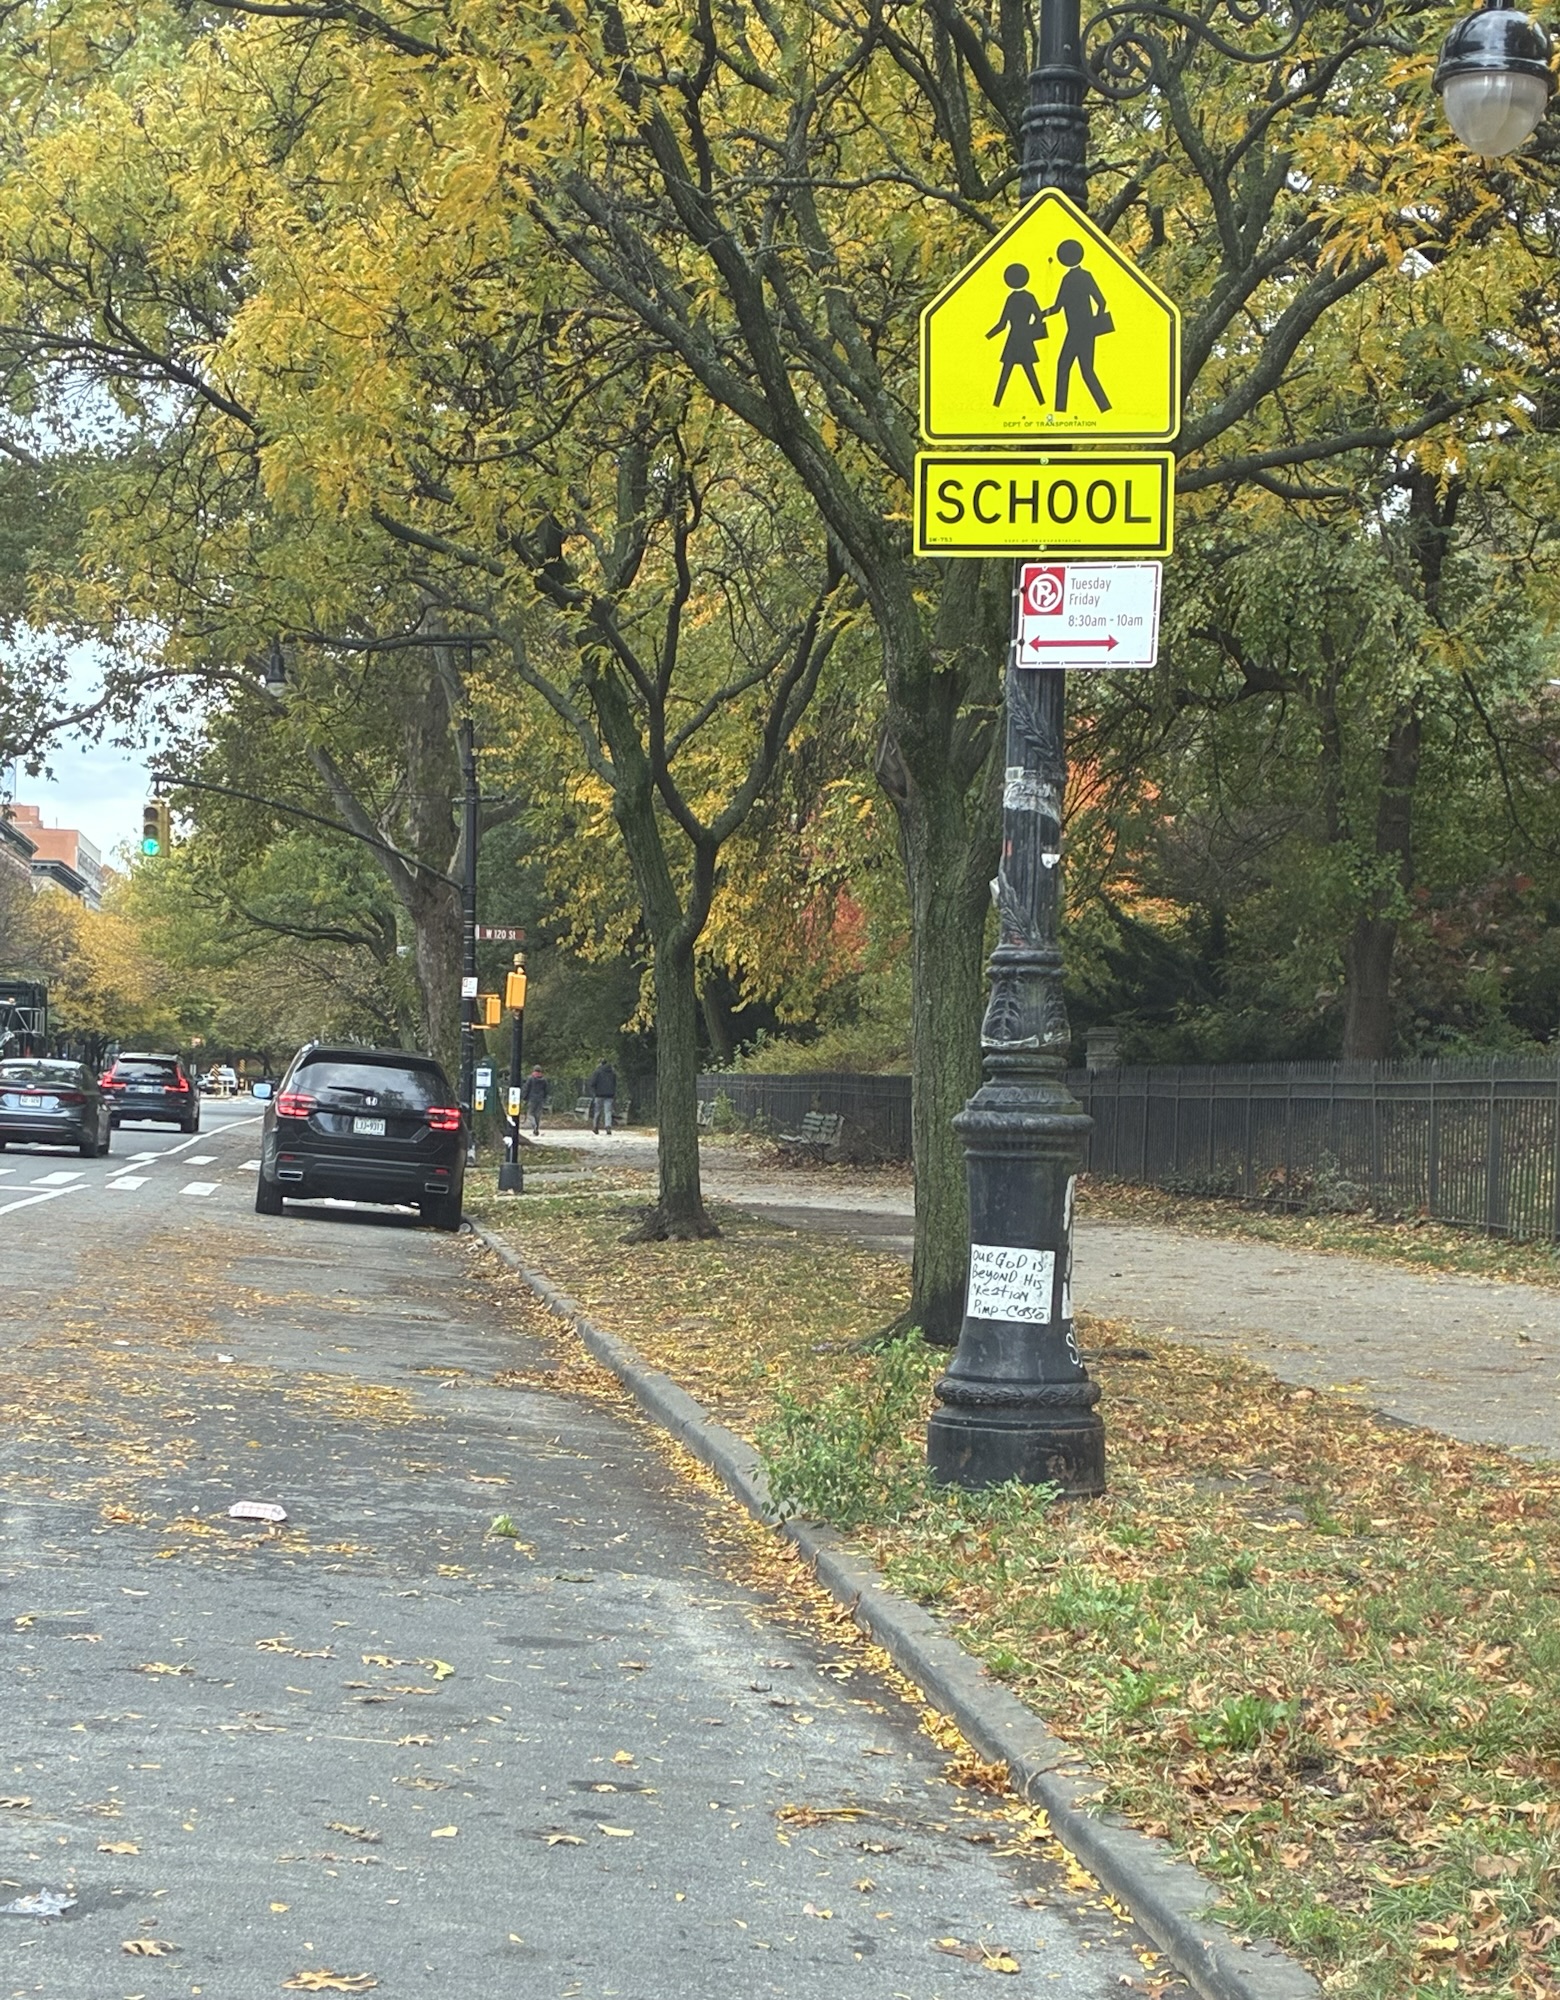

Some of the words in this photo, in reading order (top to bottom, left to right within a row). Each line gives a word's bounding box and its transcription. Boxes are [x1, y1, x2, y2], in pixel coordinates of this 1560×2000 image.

[1036, 420, 1097, 428] TRANSPORTATION
[936, 479, 1152, 524] SCHOOL
[1071, 577, 1111, 592] Tuesday
[1069, 593, 1100, 608] Friday
[1068, 614, 1107, 628] 8:30am
[1117, 613, 1143, 627] 10am
[486, 928, 493, 939] W
[494, 929, 507, 940] 120
[508, 930, 516, 940] St
